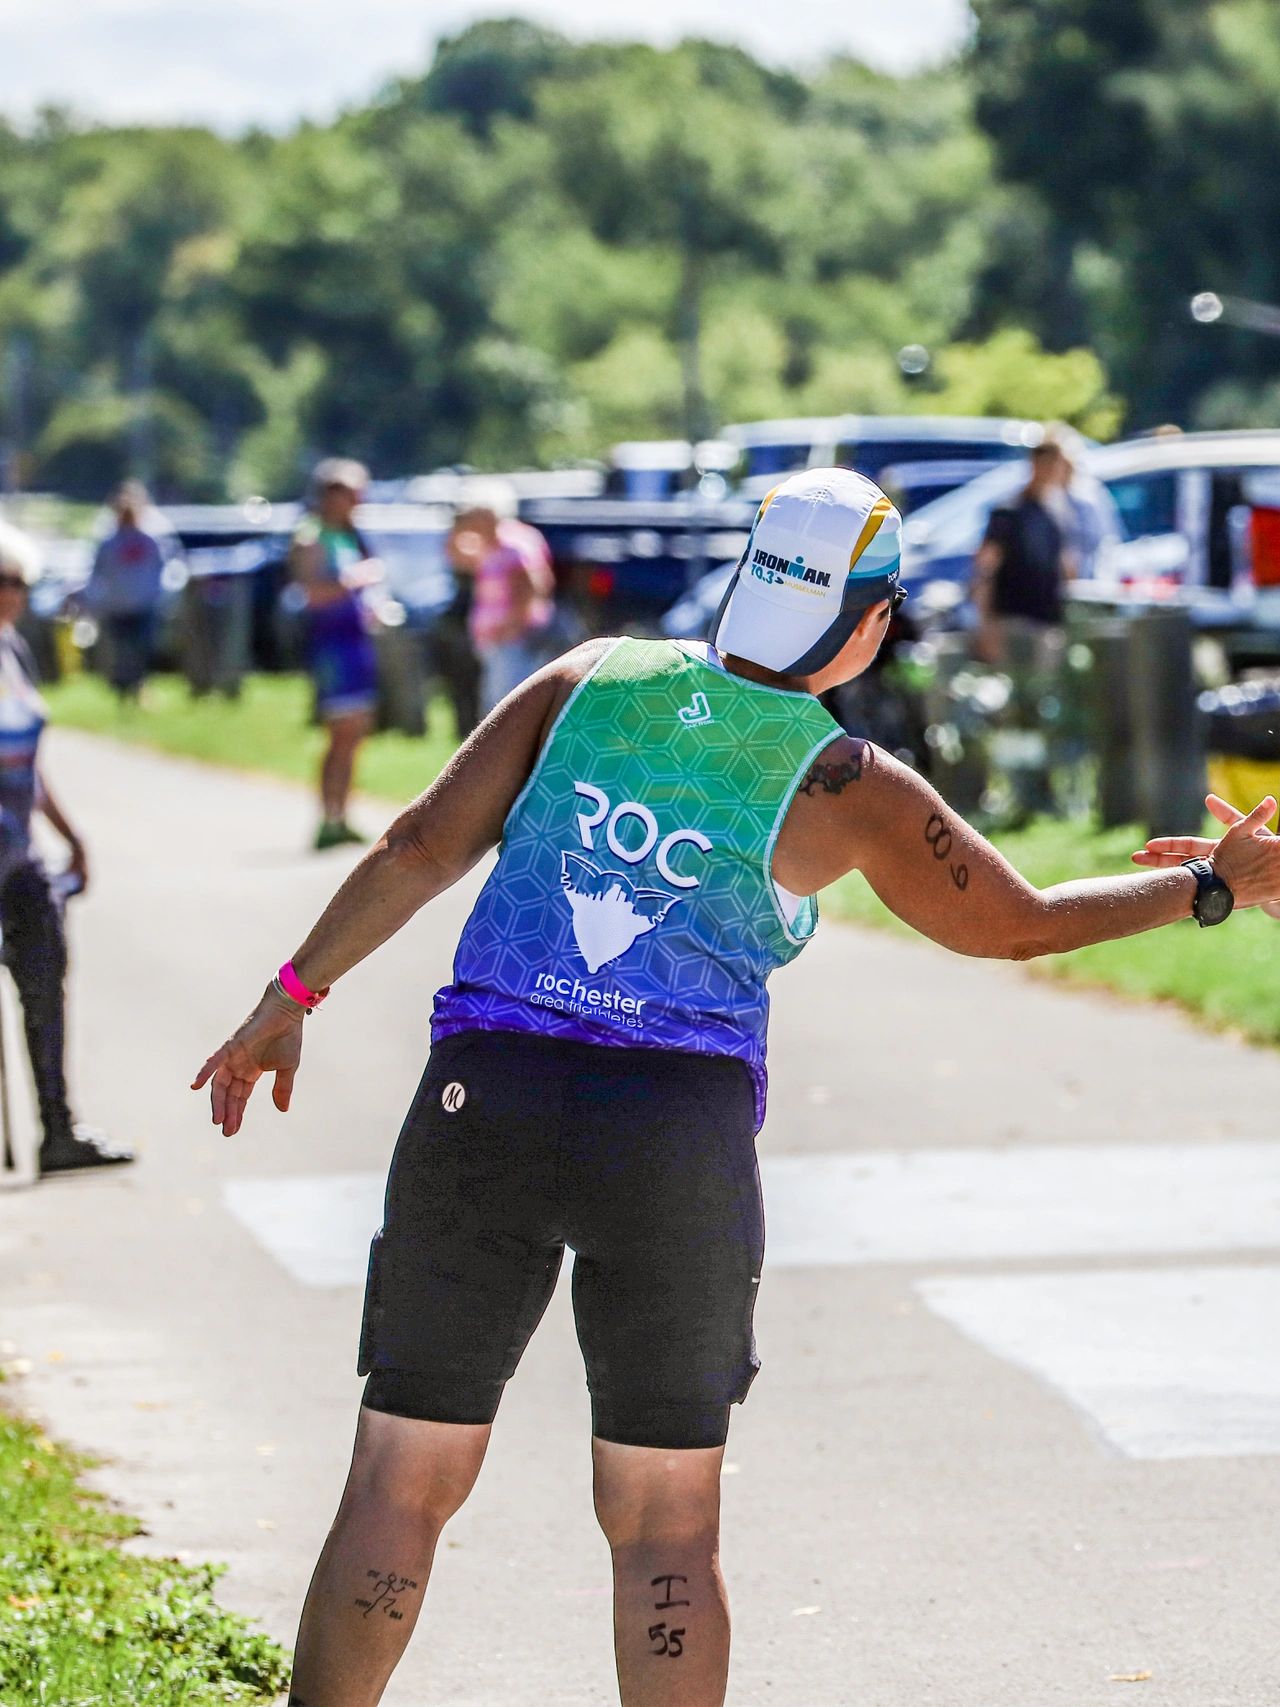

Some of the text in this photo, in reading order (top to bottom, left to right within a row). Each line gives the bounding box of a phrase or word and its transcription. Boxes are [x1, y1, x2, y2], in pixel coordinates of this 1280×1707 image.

[751, 564, 774, 585] 70.3
[573, 780, 713, 889] ROC
[530, 993, 644, 1029] area triathletes
[535, 972, 647, 1016] rochester
[648, 1622, 686, 1658] 55
